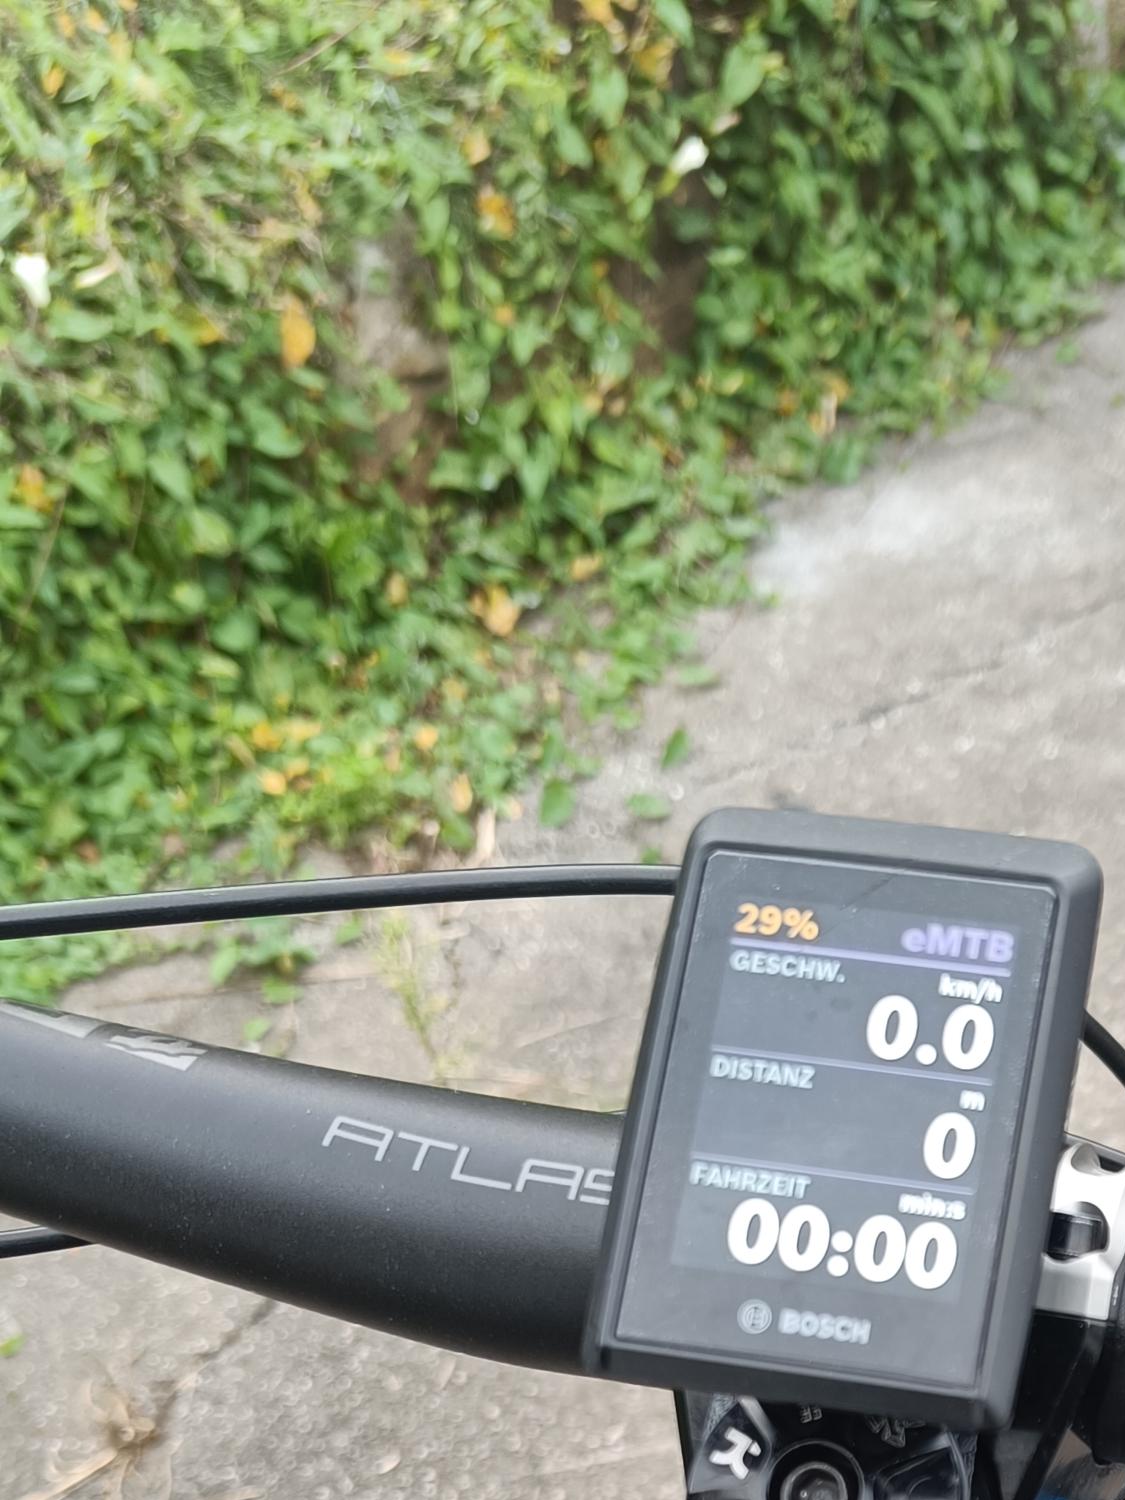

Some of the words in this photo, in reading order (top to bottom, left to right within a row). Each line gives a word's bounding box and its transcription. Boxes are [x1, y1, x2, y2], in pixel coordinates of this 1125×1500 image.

[734, 902, 819, 941] 29%
[902, 923, 1015, 964] eMTB
[730, 950, 845, 983] GESCHW.
[939, 974, 1003, 1003] km/h
[866, 995, 995, 1071] 0.0
[710, 1055, 816, 1090] DISTANZ
[923, 1112, 976, 1180] 0
[690, 1161, 812, 1199] FAHRZEIT
[727, 1198, 958, 1290] 00:00
[778, 1310, 872, 1344] BOSCH
